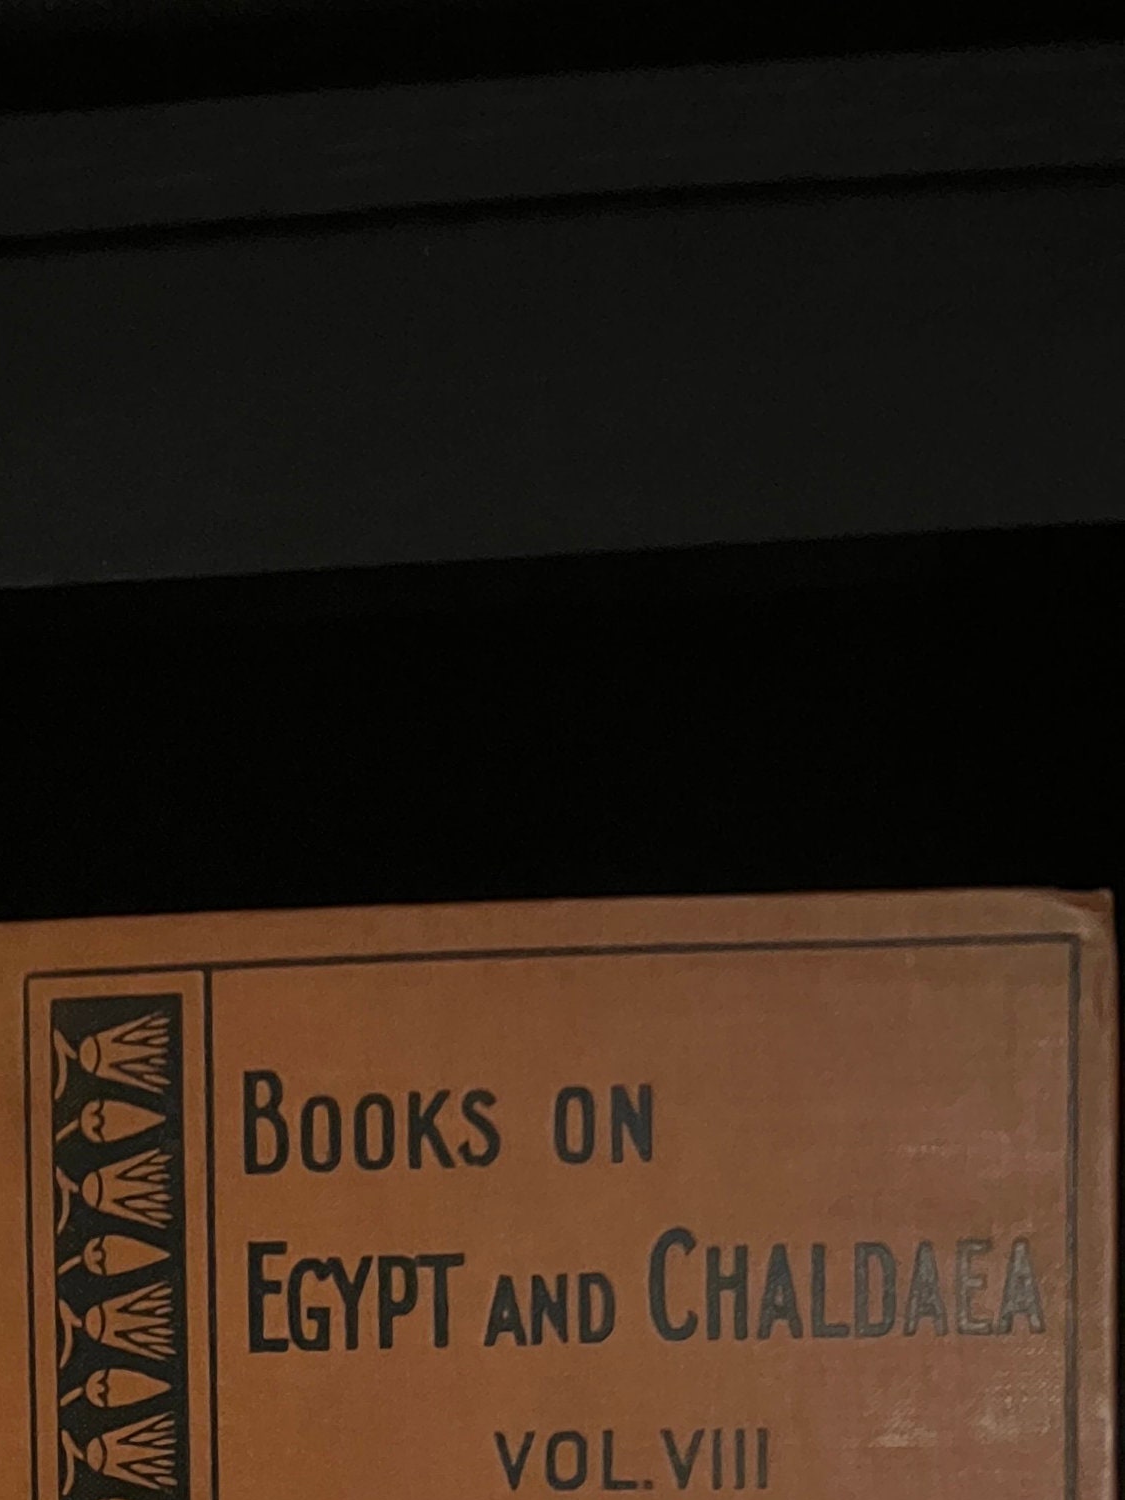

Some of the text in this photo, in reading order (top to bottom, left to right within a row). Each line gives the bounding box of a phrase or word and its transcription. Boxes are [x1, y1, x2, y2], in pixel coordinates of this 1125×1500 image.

[243, 1069, 654, 1176] BOOKS ON
[247, 1226, 1046, 1353] EGYPT AND CHALDAEA
